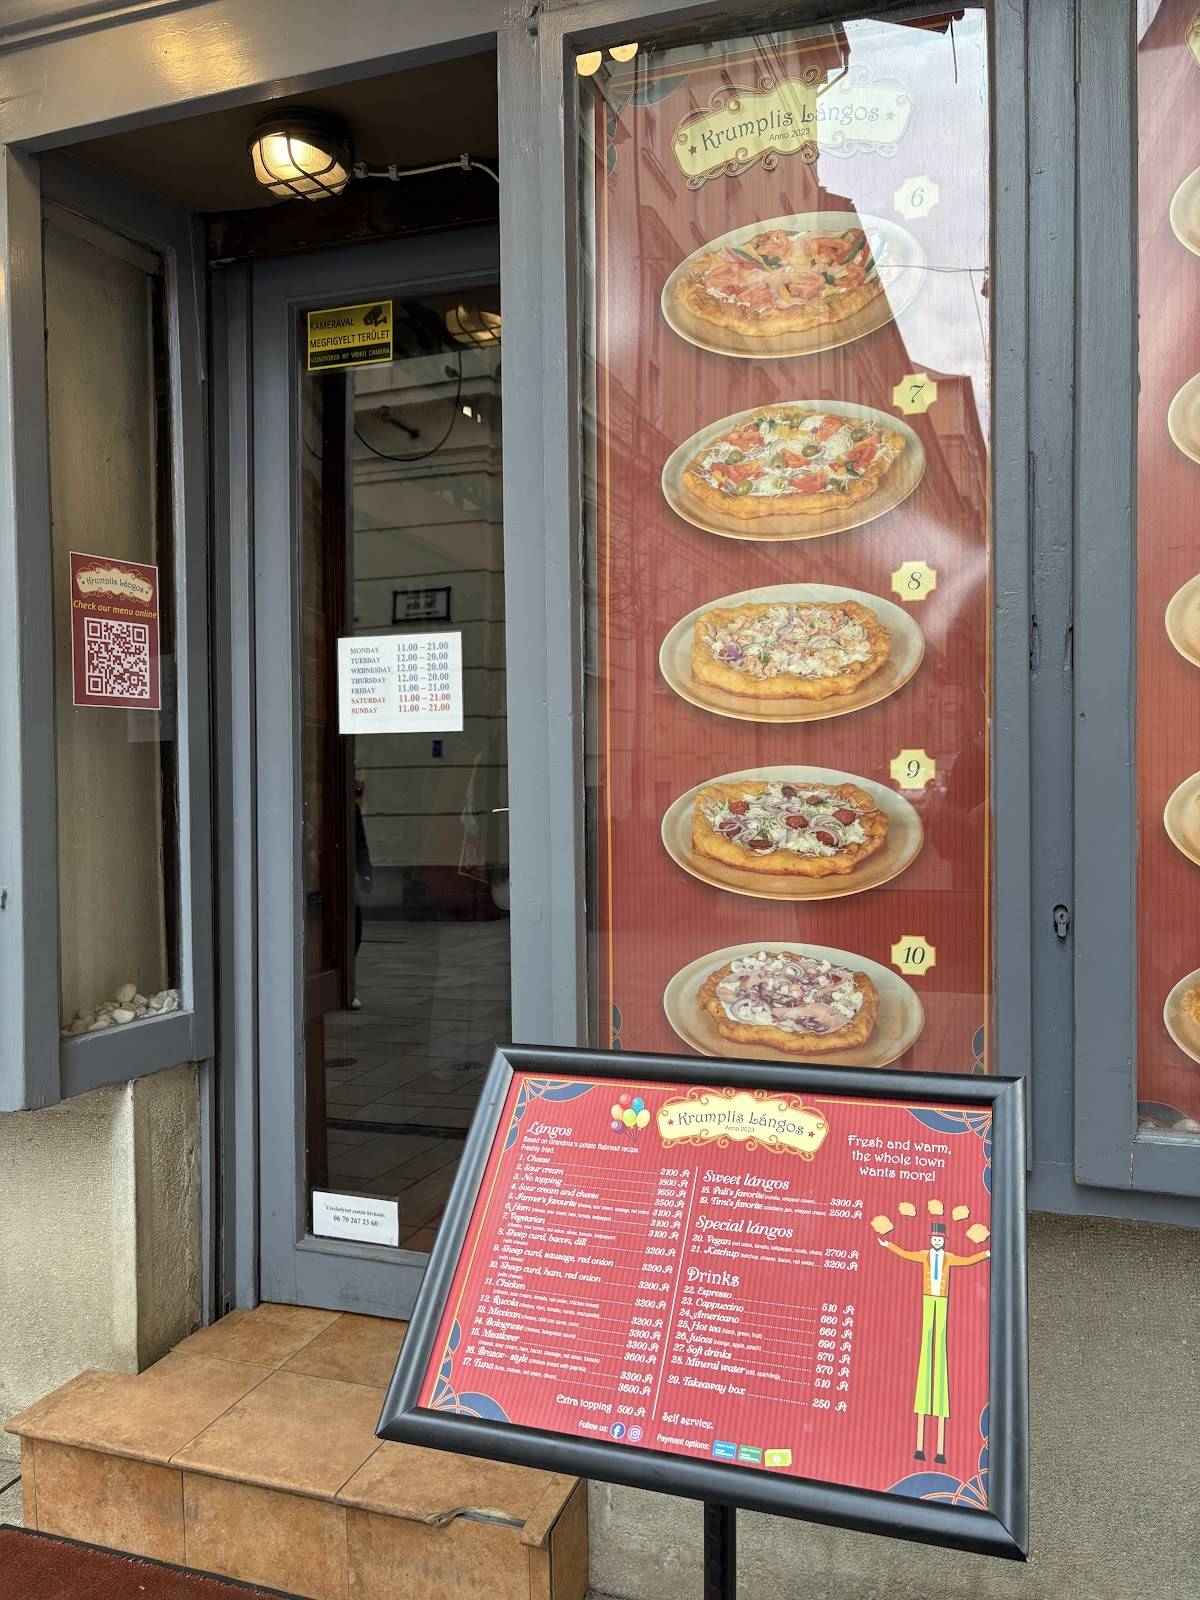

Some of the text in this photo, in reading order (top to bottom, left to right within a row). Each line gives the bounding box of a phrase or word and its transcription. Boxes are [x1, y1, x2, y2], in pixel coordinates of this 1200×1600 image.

[701, 103, 879, 151] Krumplis Lángos
[769, 127, 810, 142] Anno 2023
[910, 188, 925, 208] 6
[310, 329, 390, 348] MEGFIGYELT TERÜLET
[910, 384, 925, 403] 7
[87, 577, 144, 593] Krumplis Lángos
[908, 572, 921, 590] 8
[73, 600, 97, 610] Check
[113, 607, 134, 615] menu
[135, 610, 157, 618] online
[397, 643, 418, 651] 11.00
[427, 642, 448, 650] 21.00
[397, 653, 418, 662] 12.00
[427, 652, 448, 660] 20.00
[397, 664, 418, 672] 12.00
[427, 662, 448, 671] 20.00
[397, 674, 418, 682] 12.00
[428, 672, 449, 681] 20.00
[398, 684, 418, 692] 11.00
[428, 683, 449, 691] 21.00
[399, 694, 420, 702] 11.00
[429, 693, 451, 701] 21.00
[399, 704, 419, 712] 11.00
[429, 703, 450, 711] 21.00
[906, 760, 921, 778] 9
[904, 947, 925, 964] 10
[527, 1121, 572, 1138] Lángos
[679, 1109, 805, 1136] Krumplis Lángos
[848, 1134, 952, 1154] Fresh and warm,
[527, 1154, 679, 1176] Cheese 2100
[851, 1150, 945, 1168] the whole town
[521, 1173, 675, 1197] No topping 1650
[524, 1163, 677, 1187] Sour cream 1800
[703, 1170, 789, 1192] Sweet lángos
[859, 1166, 937, 1183] wants more!
[518, 1183, 674, 1207] Sour cream and cheese 2500
[510, 1213, 545, 1224] Vegetarian
[648, 1230, 667, 1239] 3100
[511, 1203, 669, 1228] Ham 3100
[696, 1216, 793, 1240] Special lángos
[506, 1228, 527, 1239] Sheep
[528, 1232, 547, 1241] curd,
[549, 1234, 573, 1245] bacon,
[574, 1238, 587, 1246] dill
[645, 1246, 665, 1256] 3200
[707, 1235, 847, 1258] Vegan 2700
[501, 1245, 662, 1273] Sheep curd, sausage, red onion 3200
[704, 1246, 740, 1259] Ketchup
[824, 1260, 846, 1269] 3200
[500, 1262, 658, 1289] Sheep curd, ham, red onion 3200
[687, 1267, 740, 1288] Drinks
[496, 1278, 655, 1308] Chicken 3200
[697, 1287, 837, 1313] Espresso 510
[493, 1295, 519, 1308] Rucola
[631, 1316, 651, 1326] 3200
[696, 1299, 838, 1325] Cappuccino 660
[691, 1310, 837, 1338] Americano 660
[482, 1329, 520, 1342] Meatlover
[624, 1352, 645, 1362] 3600
[688, 1321, 836, 1350] Hot tea 690
[686, 1332, 713, 1344] Juices
[817, 1352, 834, 1362] 870
[686, 1344, 703, 1357] Soft
[704, 1349, 732, 1360] drinks
[815, 1365, 833, 1375] 870
[474, 1358, 639, 1393] Tuna 3600
[685, 1357, 831, 1389] Mineral water 510
[683, 1376, 830, 1409] Takeaway box 250
[556, 1394, 633, 1415] Extra topping 500
[579, 1420, 608, 1432] Follow us:
[662, 1411, 714, 1430] Self service.
[656, 1433, 683, 1447] Payment
[684, 1438, 710, 1450] options:
